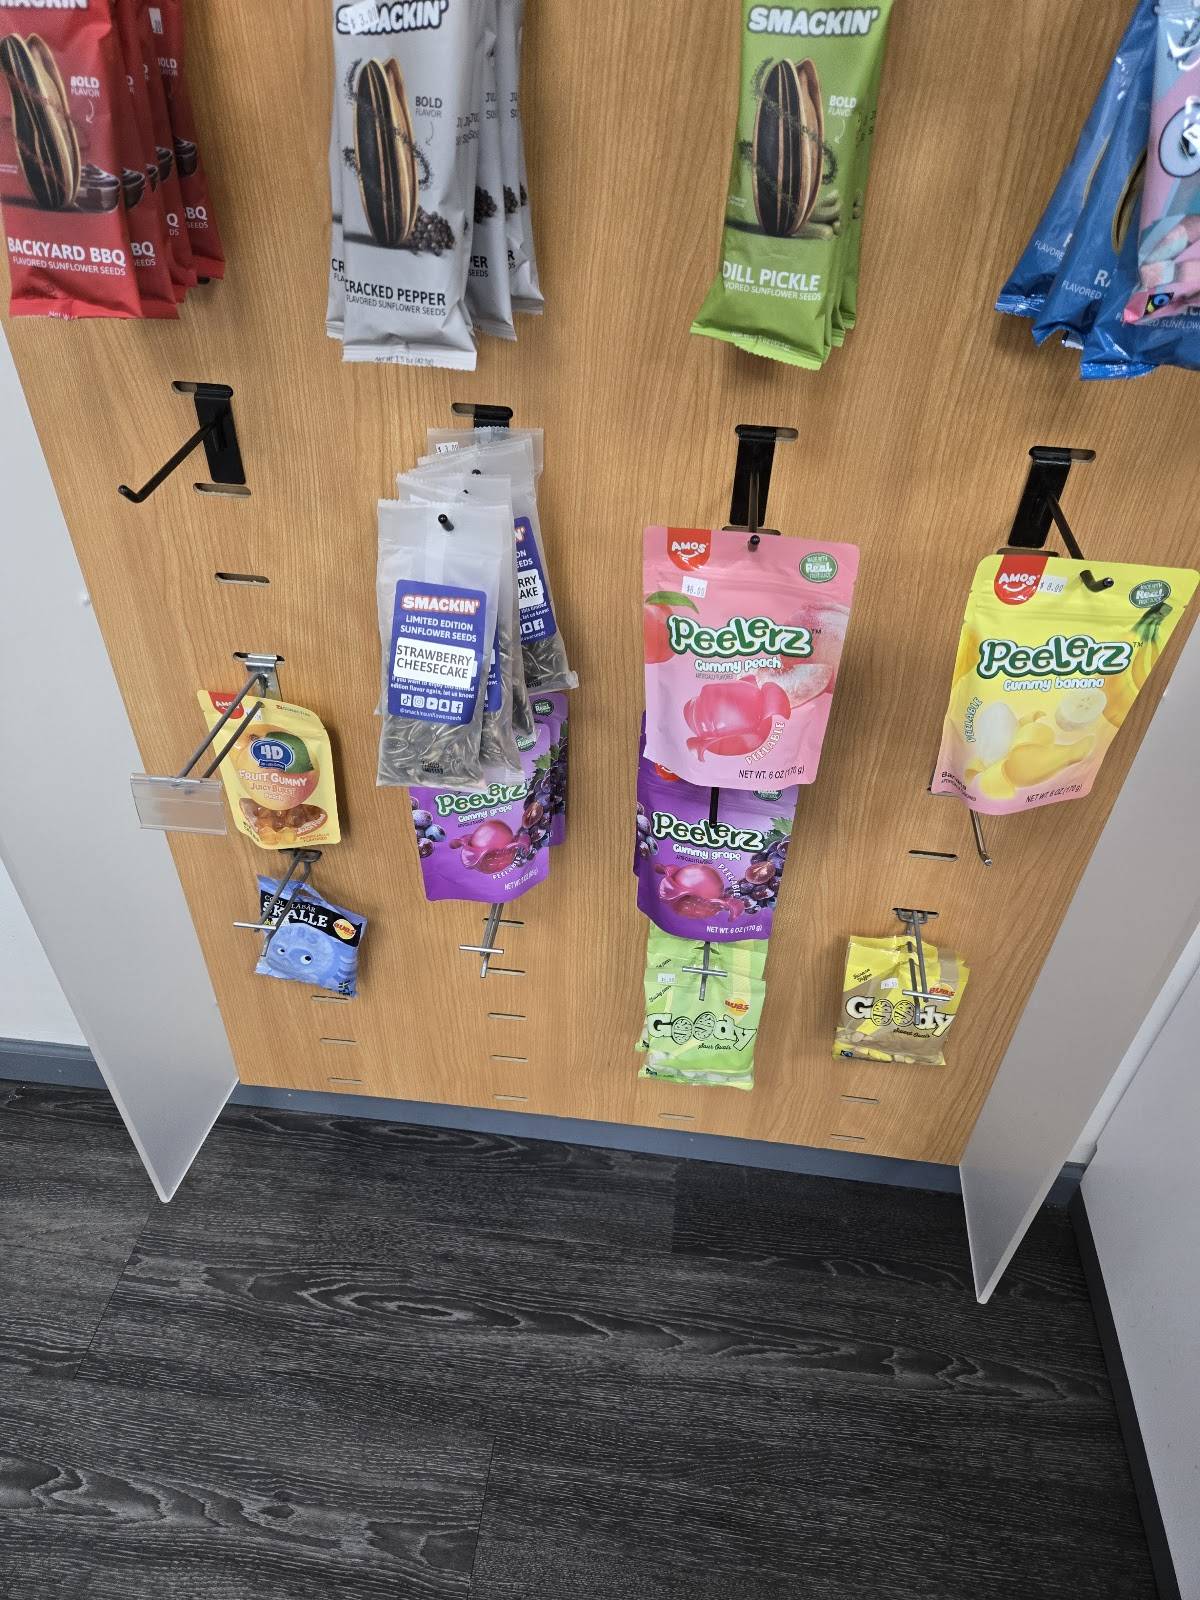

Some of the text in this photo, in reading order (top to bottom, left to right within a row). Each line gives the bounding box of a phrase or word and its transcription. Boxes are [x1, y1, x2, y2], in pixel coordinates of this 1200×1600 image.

[336, 0, 448, 34] SACKIN'
[748, 6, 879, 36] SMACKIN'
[70, 76, 100, 88] BOLD
[415, 96, 442, 108] BOLD
[829, 95, 857, 108] BOLD
[415, 107, 442, 118] FLAVOR
[7, 236, 126, 267] BACKYARD BBQ
[1034, 240, 1065, 260] FLAVORE
[13, 256, 126, 276] FLAVORED SUNFLOWER SEEDS
[722, 261, 821, 292] DILL PICKLE
[344, 280, 446, 306] CRACKED PEPPER
[751, 286, 798, 300] SUNFLOWER
[799, 292, 822, 302] SEEDS
[1061, 280, 1102, 299] FLAVORED
[346, 295, 447, 317] FLAVORED SUNFLOWER SEEDS
[671, 541, 706, 554] AMOS
[998, 572, 1037, 586] AMOS
[402, 595, 480, 614] SMACKIN'
[405, 615, 474, 632] LIMITED EDITION
[400, 624, 477, 643] SUNFLOWER SEEDS
[396, 644, 473, 667] STRAWBERRY
[694, 656, 782, 674] Gummy peach
[396, 657, 469, 679] CHEESECAKE
[390, 683, 409, 691] edition
[1003, 677, 1104, 692] Gummy banana
[260, 744, 284, 760] 4D
[745, 720, 785, 765] PEELABLE
[239, 770, 307, 787] FRUIT GUMMY
[738, 769, 753, 779] NET
[774, 769, 785, 779] OZ
[458, 804, 513, 823] Gummy grape
[673, 843, 709, 859] Gummy
[711, 851, 742, 861] grape
[717, 863, 741, 898] PEELABLE
[706, 925, 718, 933] NET
[845, 995, 956, 1037] Goody
[646, 1011, 757, 1051] Goody
